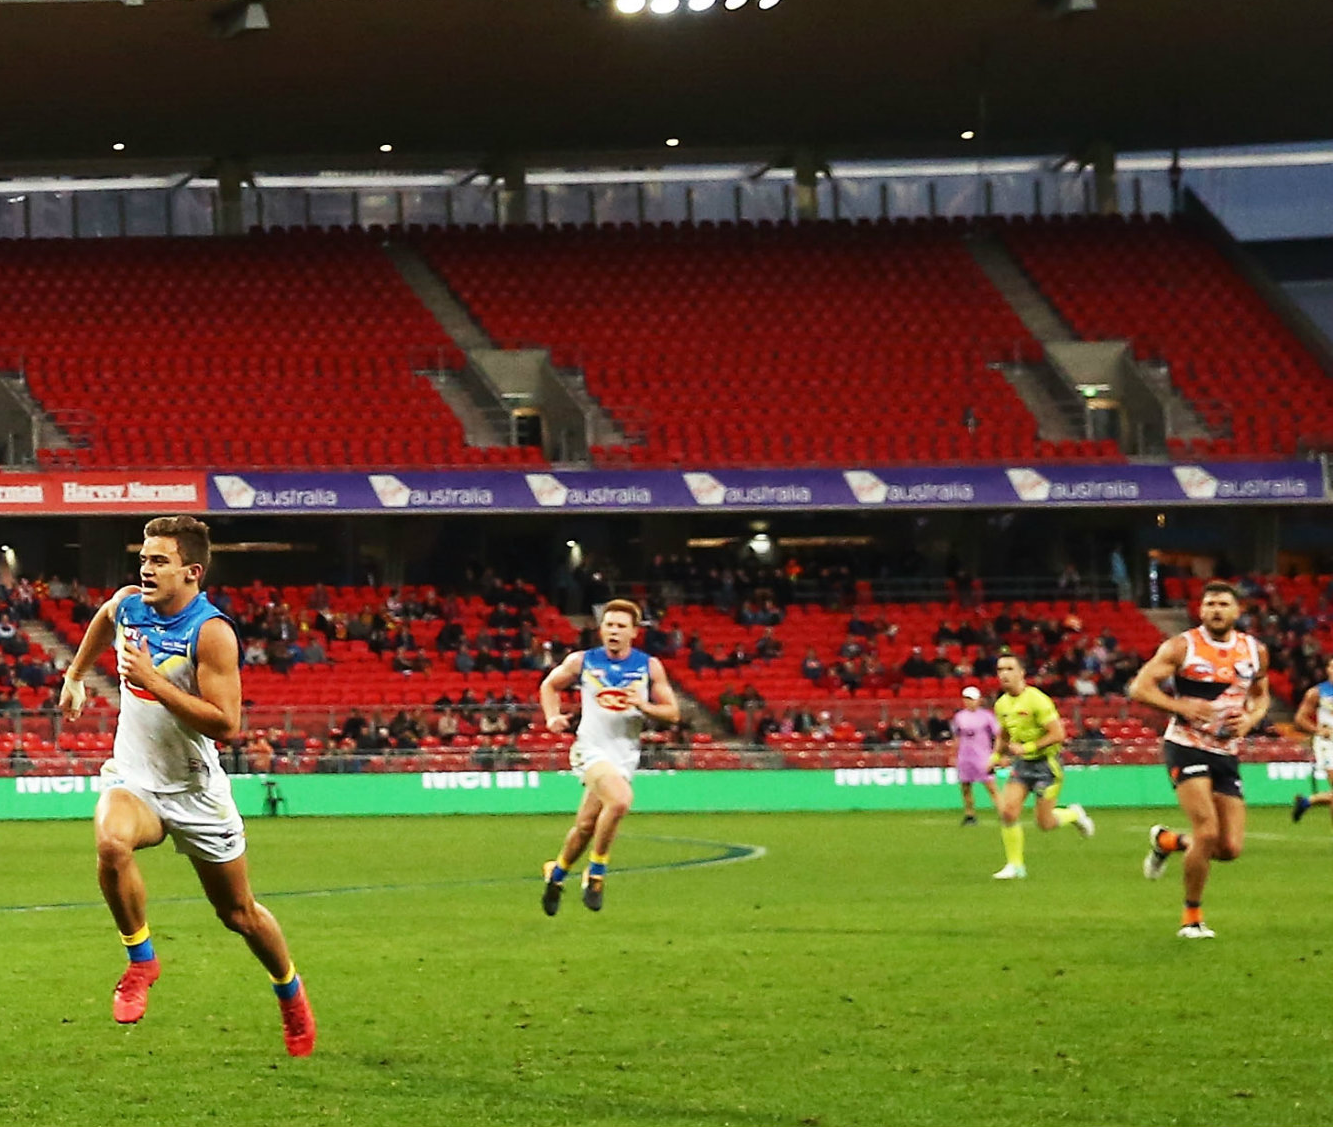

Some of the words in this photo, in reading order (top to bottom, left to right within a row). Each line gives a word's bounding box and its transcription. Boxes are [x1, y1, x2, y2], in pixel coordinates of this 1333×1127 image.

[255, 488, 338, 506] australia
[410, 487, 494, 506] australia
[567, 486, 652, 505] australia
[725, 484, 813, 504] australia
[887, 482, 974, 502] australia
[1050, 479, 1139, 501] australia
[1217, 477, 1307, 498] australia
